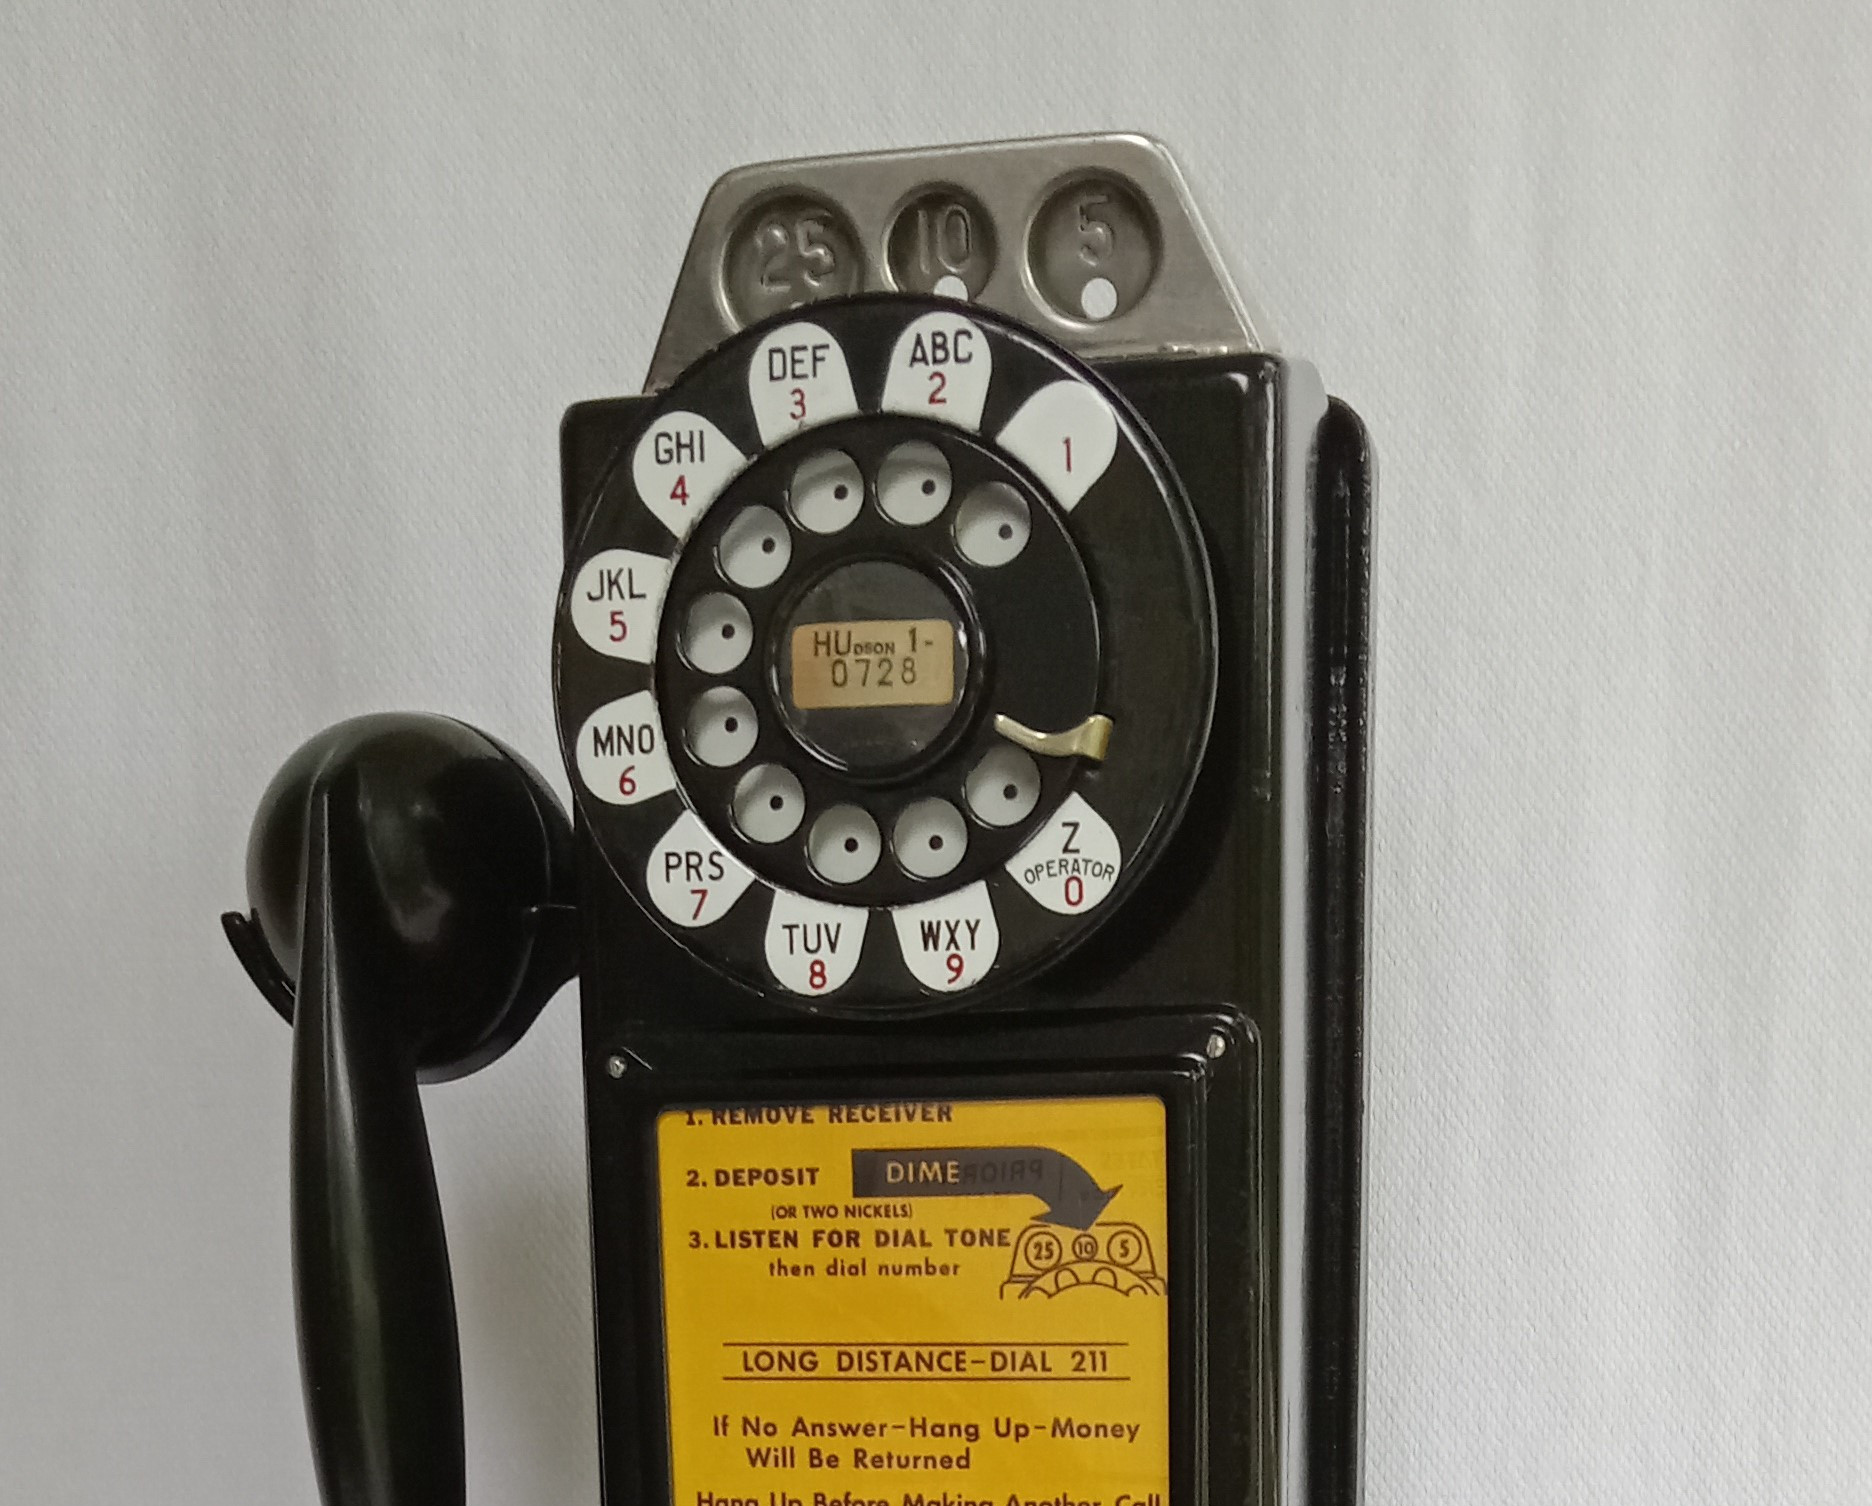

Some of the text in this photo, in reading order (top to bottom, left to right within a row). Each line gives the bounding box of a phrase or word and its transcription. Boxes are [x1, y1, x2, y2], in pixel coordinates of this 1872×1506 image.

[753, 194, 1115, 293] 25 10 5
[768, 343, 830, 382] DEF
[909, 328, 973, 368] ABC
[928, 371, 947, 405] 2
[790, 388, 807, 421] 3
[654, 430, 705, 465] GHI
[1063, 437, 1072, 473] 1
[669, 475, 689, 506] 4
[586, 568, 647, 602] JKL
[609, 610, 627, 642] 5
[813, 627, 934, 657] HUDSON 1-
[831, 657, 918, 688] 0728
[593, 724, 655, 758] MNO
[619, 765, 636, 796] 6
[1061, 821, 1081, 855] Z
[664, 850, 725, 883] PRS
[1023, 857, 1116, 885] OPERATOR
[690, 888, 708, 921] 7
[1064, 875, 1084, 907] 0
[782, 922, 842, 955] TUV
[920, 919, 980, 952] WXY
[809, 959, 827, 990] 8
[946, 953, 964, 985] 9
[685, 1105, 953, 1126] 1. REMOVE RECEIVER
[686, 1160, 961, 1188] 2. DEPOSIT DIME
[771, 1203, 913, 1221] (OR TWO NICKELS)
[688, 1228, 1011, 1249] 3. LISTEN FOR DIAL TONE
[1033, 1239, 1130, 1261] 25 10 5
[769, 1257, 960, 1277] then dial number
[743, 1350, 1107, 1373] LONG DISTANCE-DIAL 211
[713, 1414, 1140, 1444] If No Answer-Hang Up-Money
[745, 1446, 971, 1470] Will Be Returned
